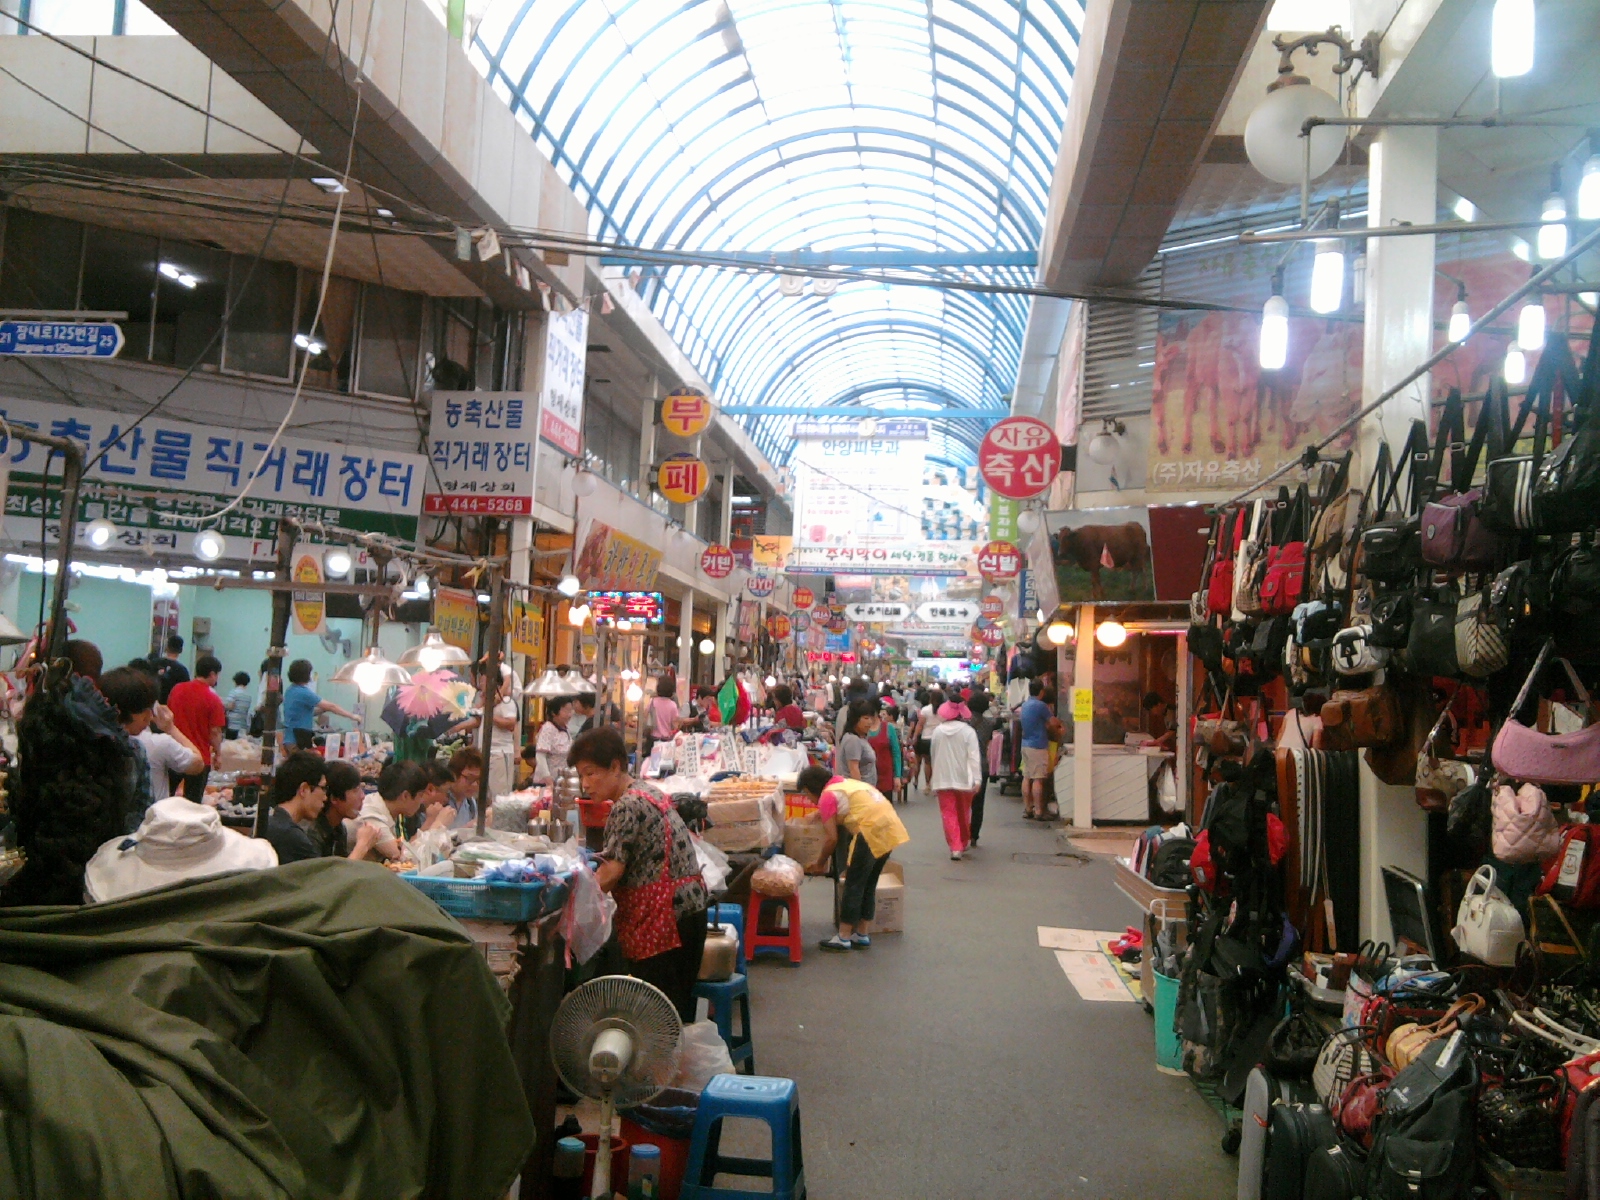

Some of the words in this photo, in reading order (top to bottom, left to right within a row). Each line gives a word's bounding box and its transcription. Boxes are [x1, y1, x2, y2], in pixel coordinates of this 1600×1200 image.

[100, 334, 114, 347] 25
[445, 399, 523, 429] 농축산물
[996, 426, 1046, 447] 자유
[433, 441, 531, 472] 직거래장터
[822, 440, 900, 456] 안양피부과
[206, 437, 414, 508] 직거래장터
[984, 452, 1056, 487] 축산
[1153, 458, 1262, 485] (주)자유축산
[703, 555, 731, 571] 커텐
[979, 554, 1018, 571] 신발
[748, 577, 773, 590] BYC
